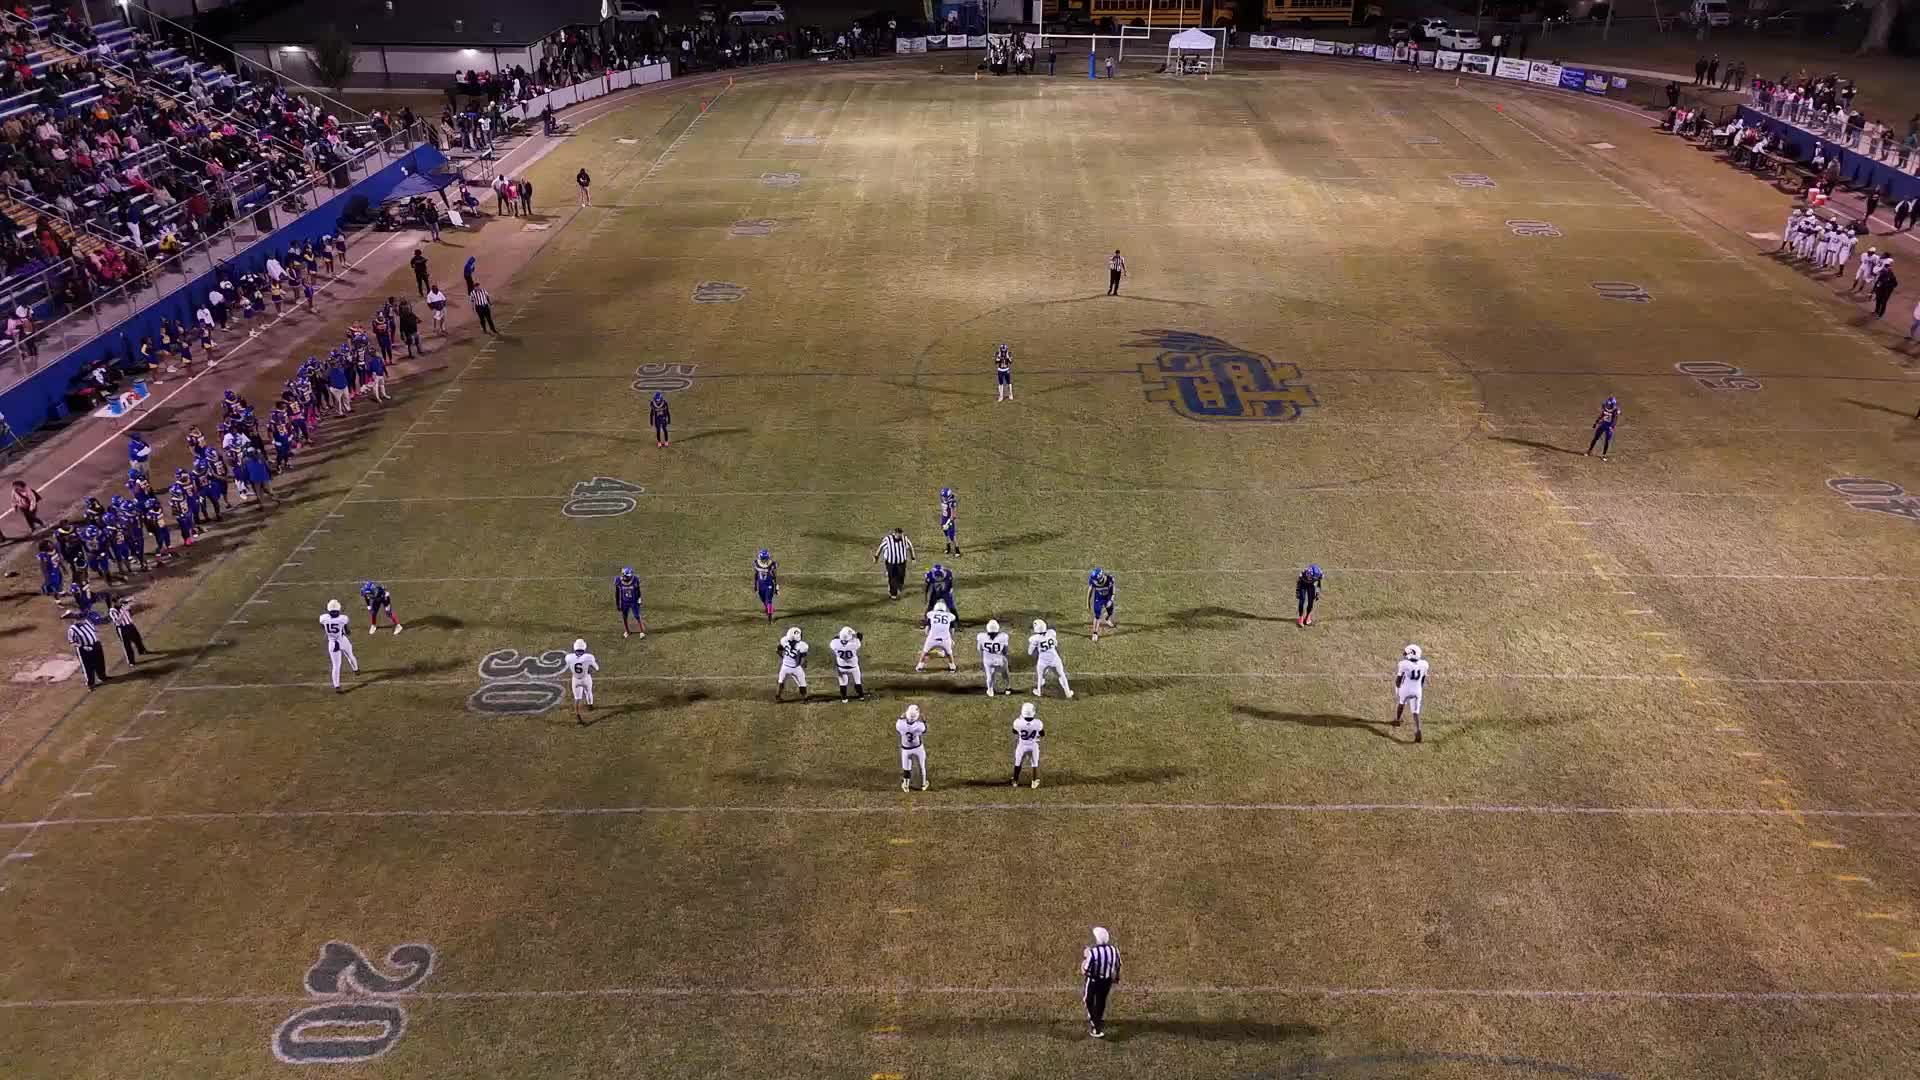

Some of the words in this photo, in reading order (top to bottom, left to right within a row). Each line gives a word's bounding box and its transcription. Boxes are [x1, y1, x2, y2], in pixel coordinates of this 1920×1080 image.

[632, 362, 698, 392] 50
[1674, 360, 1763, 392] 50
[562, 476, 645, 518] 40
[933, 614, 949, 625] 56
[325, 623, 340, 634] 15
[984, 642, 1000, 654] 50
[574, 662, 583, 674] 6
[466, 649, 570, 715] 30
[905, 731, 914, 742] 3
[1020, 729, 1037, 740] 24
[271, 939, 437, 1064] 20
